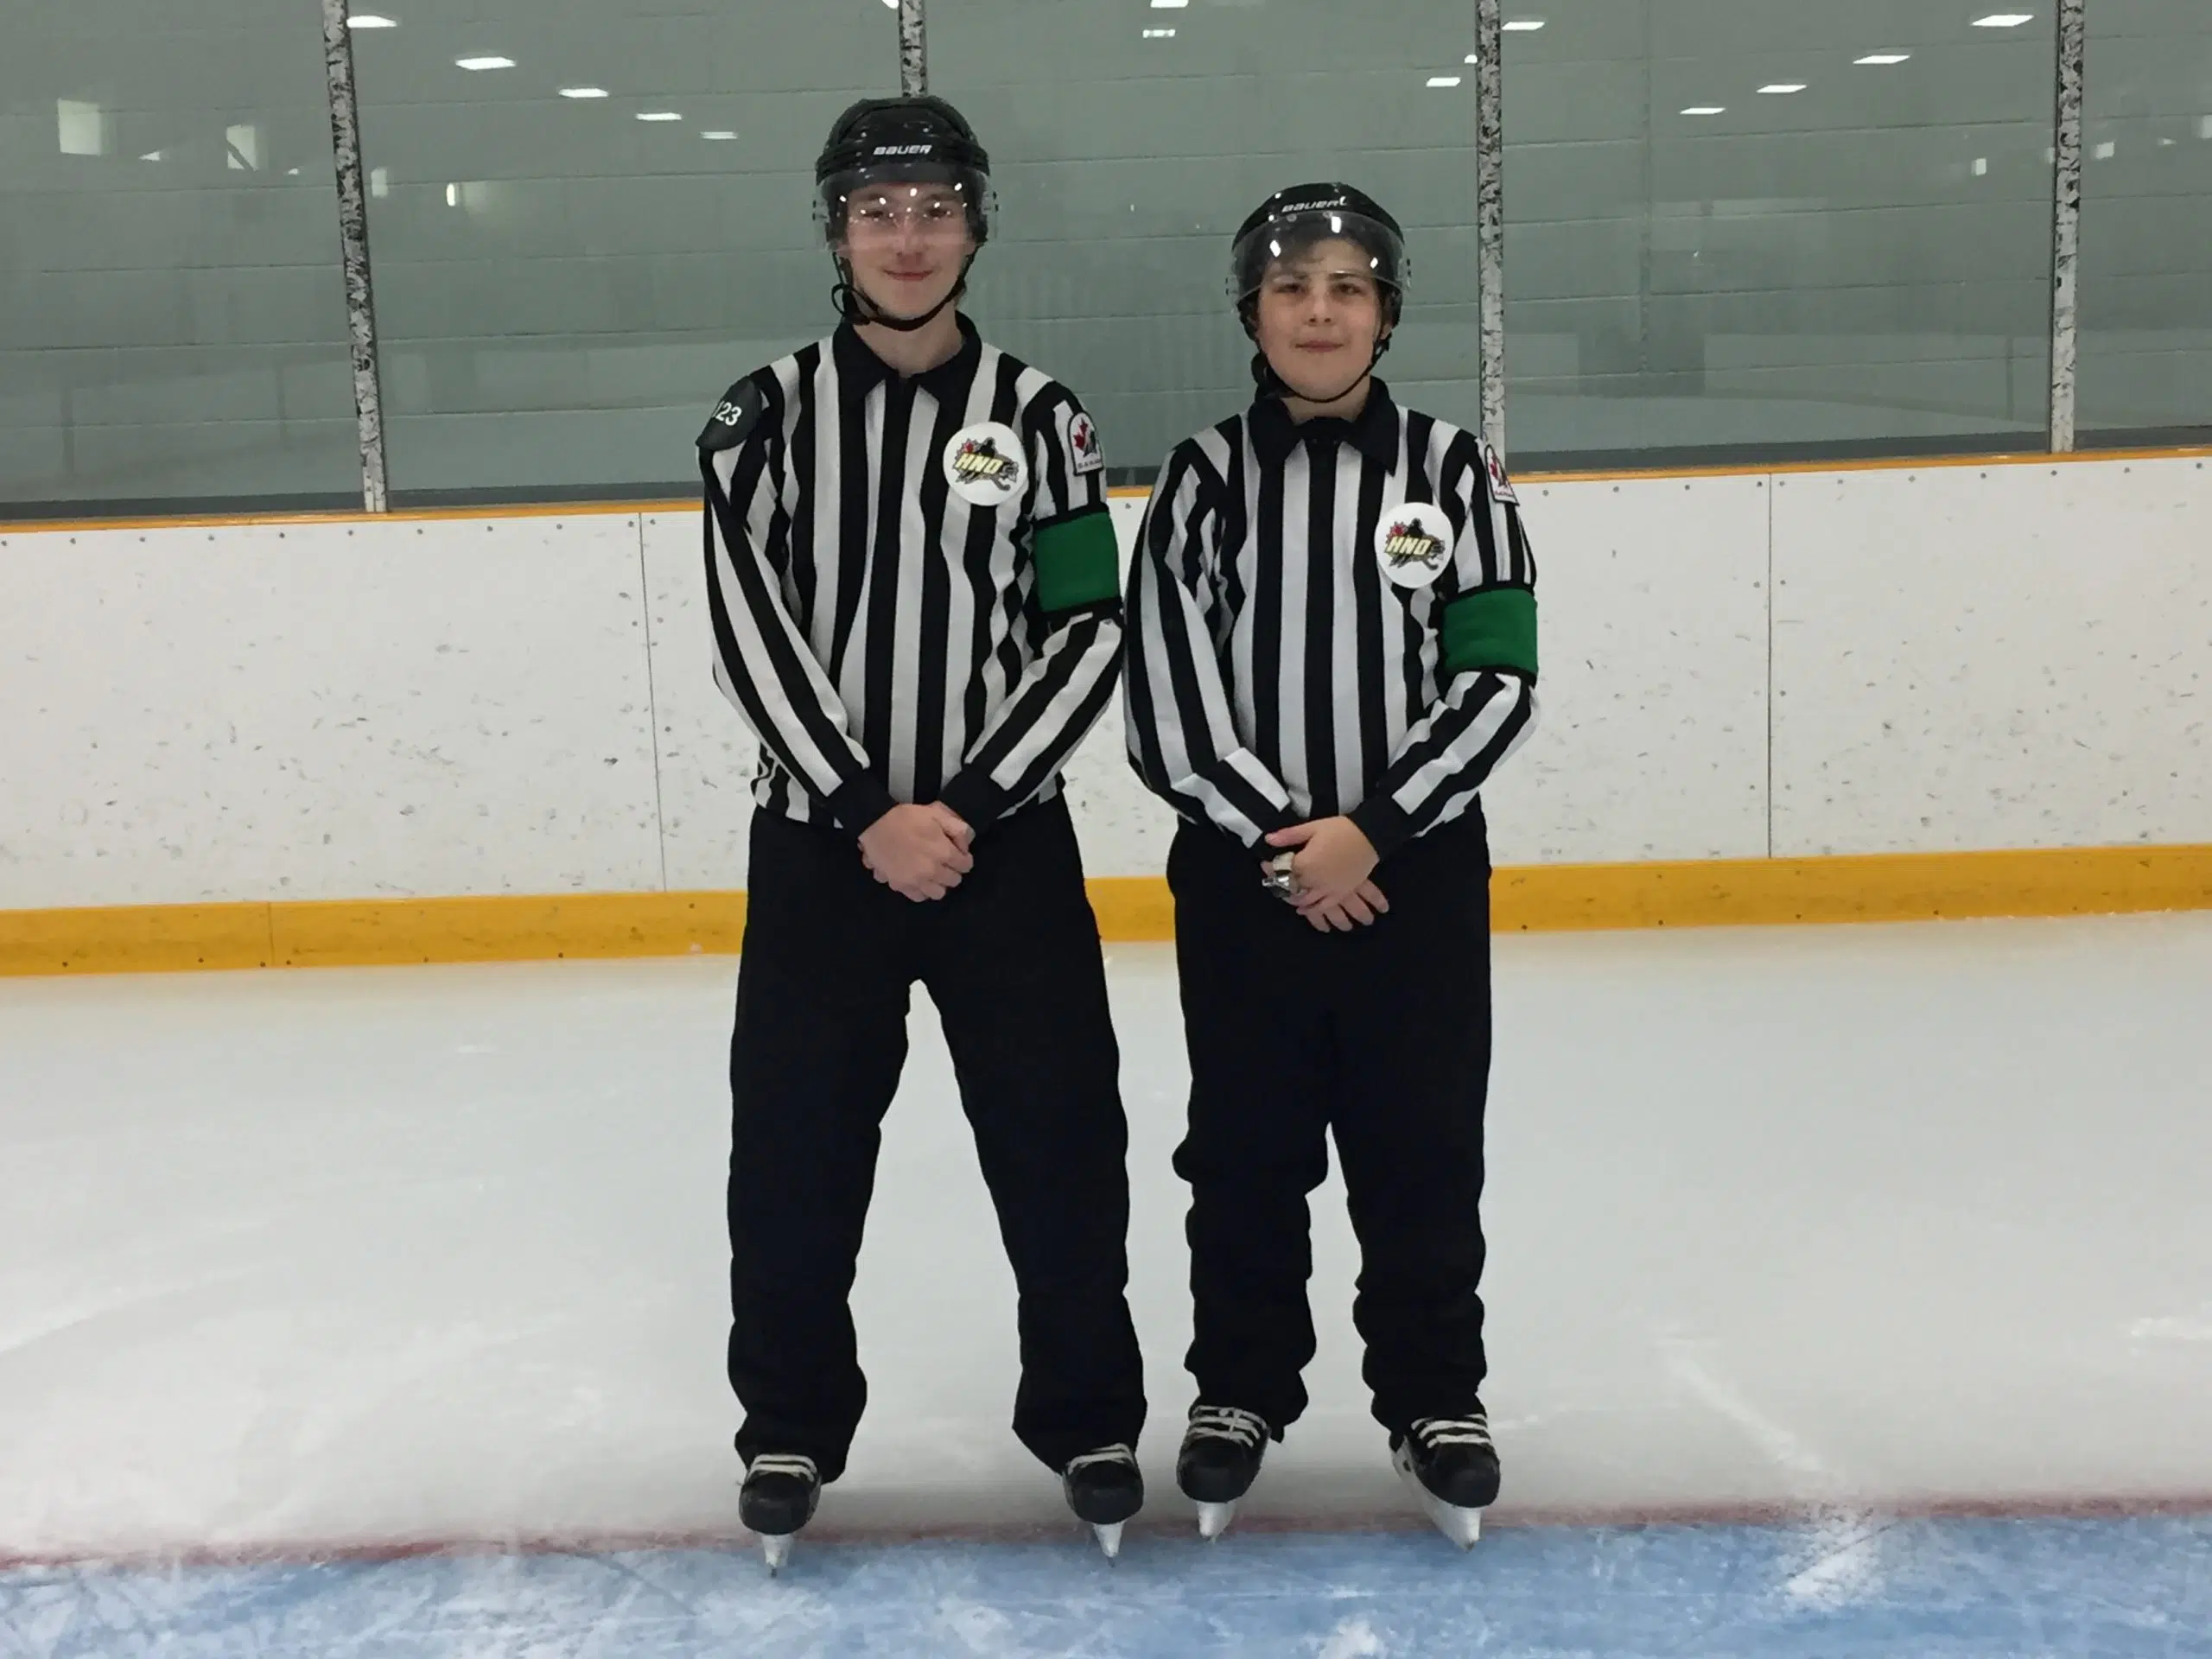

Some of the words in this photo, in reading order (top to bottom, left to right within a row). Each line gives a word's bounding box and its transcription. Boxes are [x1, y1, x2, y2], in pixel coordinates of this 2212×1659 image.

[873, 144, 932, 156] BAUER
[1281, 200, 1340, 213] BAUER
[953, 452, 1004, 475] HNO
[1385, 535, 1433, 556] HNO
